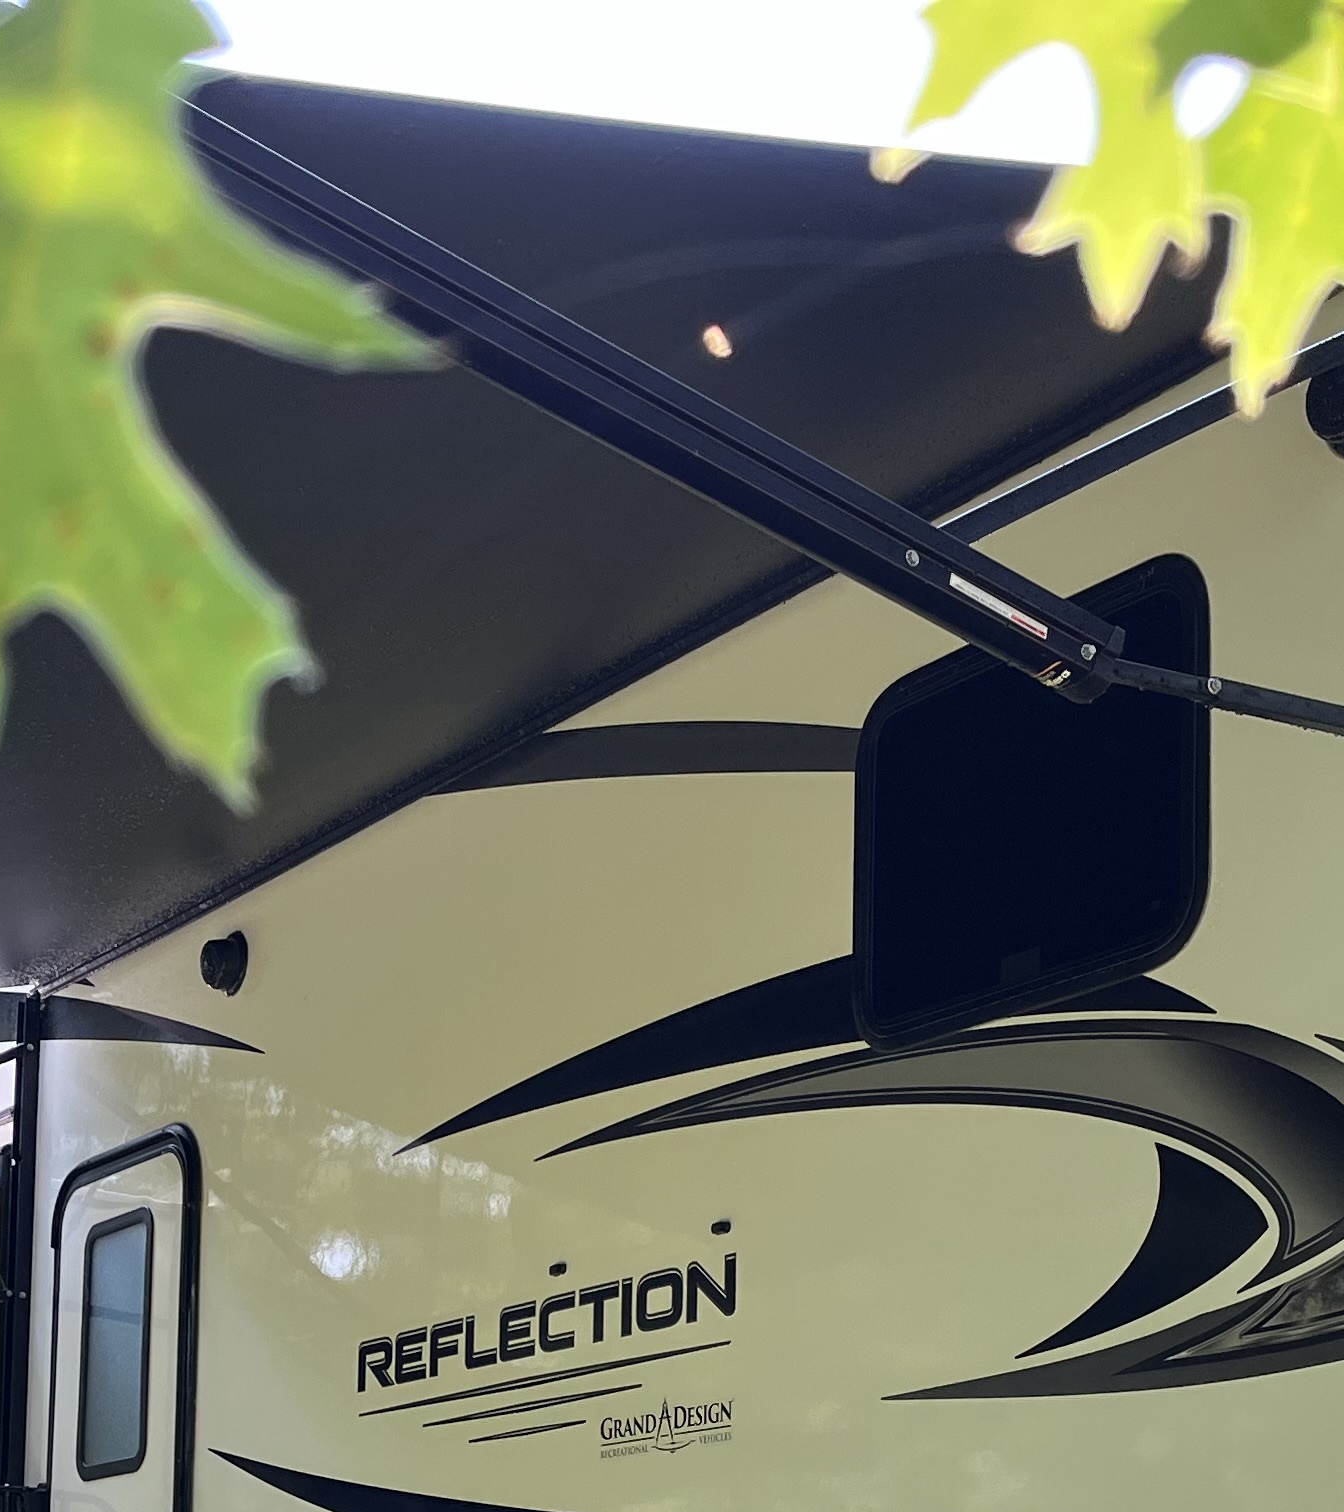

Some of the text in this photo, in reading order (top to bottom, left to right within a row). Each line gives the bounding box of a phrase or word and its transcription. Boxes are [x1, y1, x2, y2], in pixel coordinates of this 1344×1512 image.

[357, 1252, 737, 1393] REFLECTION
[600, 1400, 733, 1440] GRAND DESIGN
[600, 1432, 732, 1459] RECREATIONAL VEHICLES
